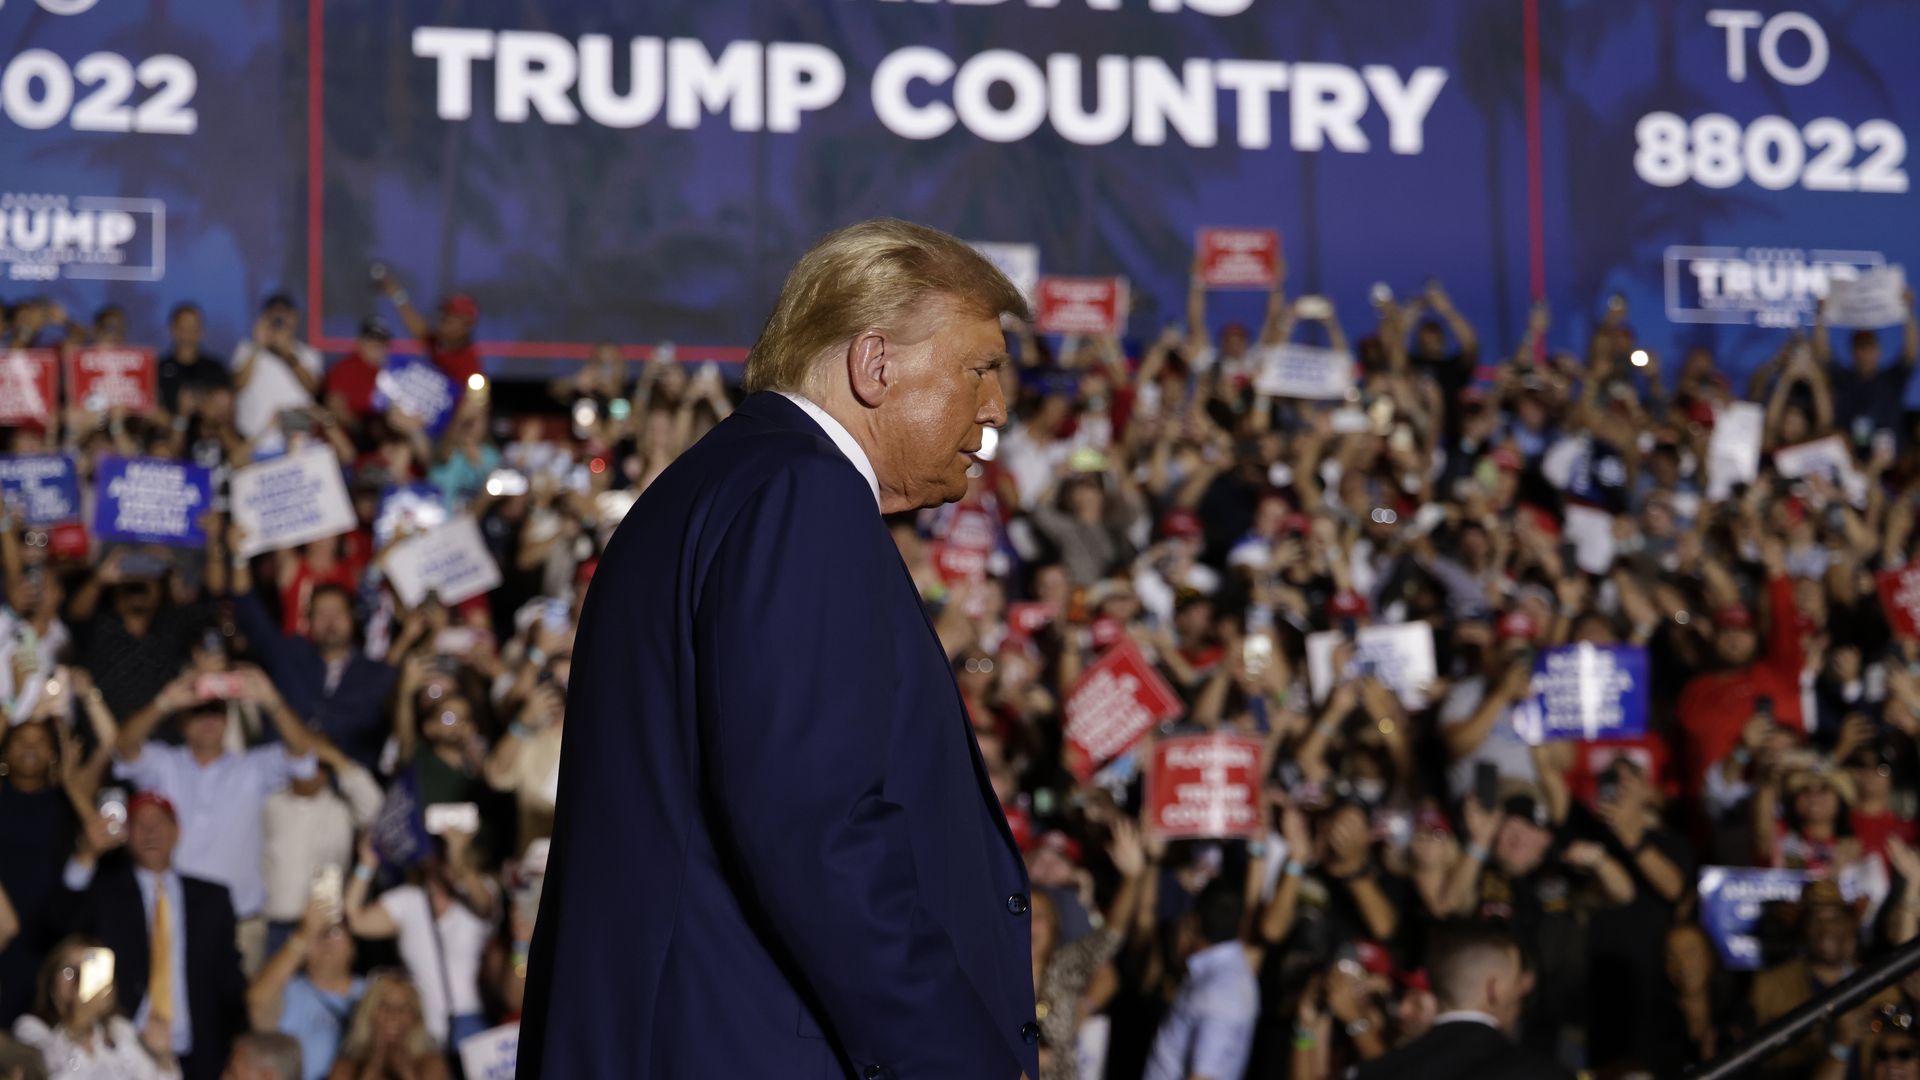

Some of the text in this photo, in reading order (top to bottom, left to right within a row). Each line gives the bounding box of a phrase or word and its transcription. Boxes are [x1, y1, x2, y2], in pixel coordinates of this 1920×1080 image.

[1705, 9, 1830, 86] TO
[0, 48, 199, 135] 022
[411, 26, 1448, 154] TRUMP COUNTRY
[1633, 111, 1910, 193] 88022
